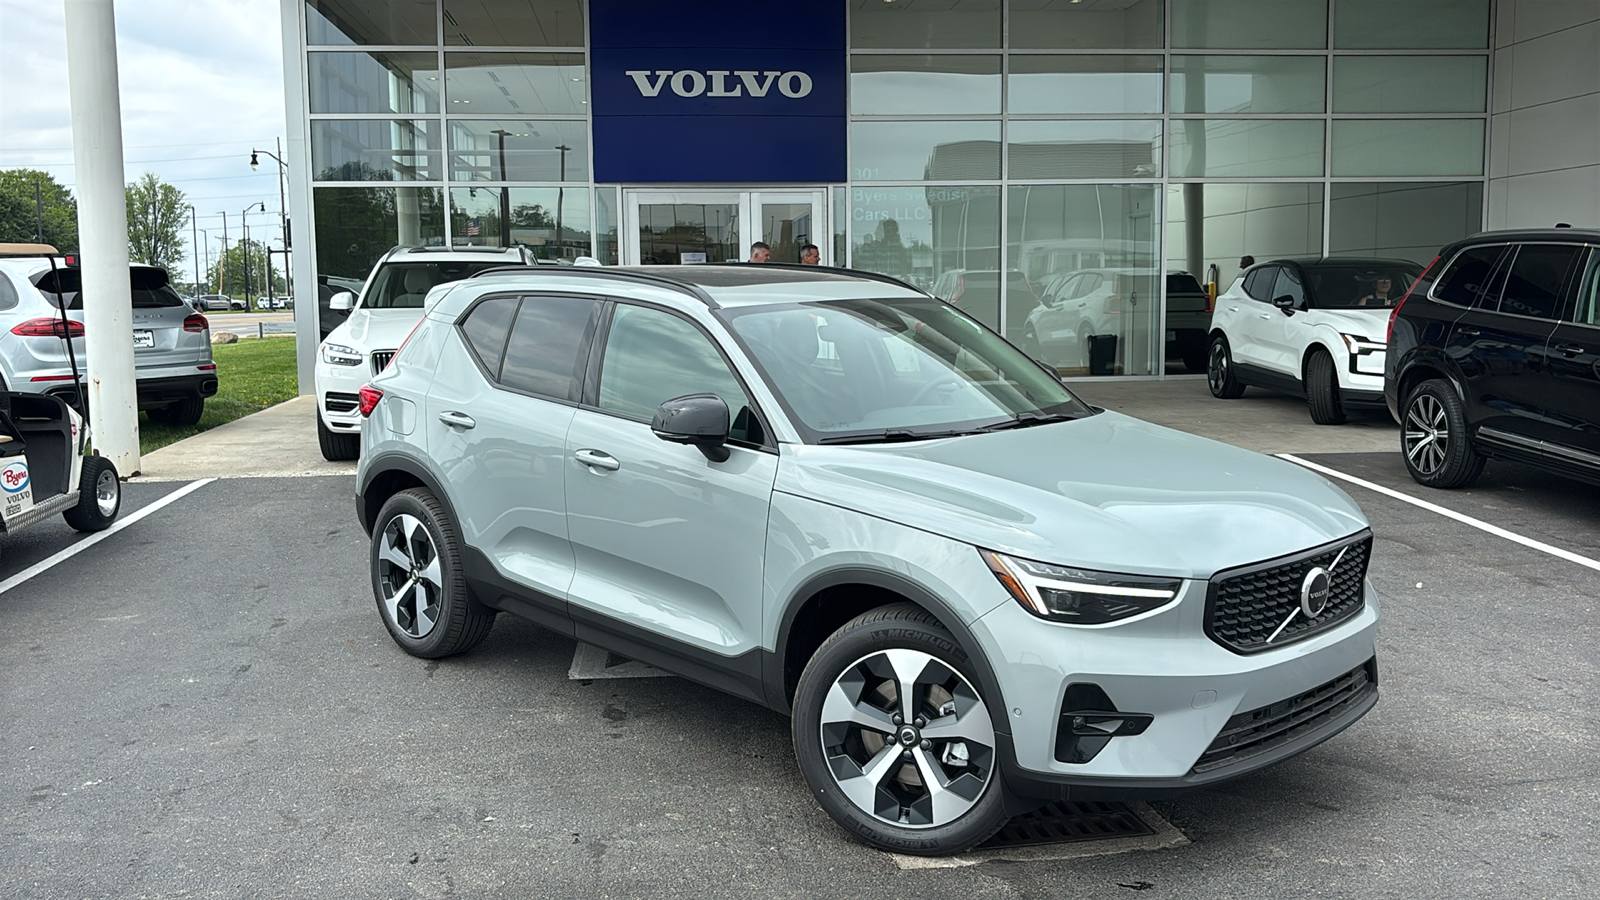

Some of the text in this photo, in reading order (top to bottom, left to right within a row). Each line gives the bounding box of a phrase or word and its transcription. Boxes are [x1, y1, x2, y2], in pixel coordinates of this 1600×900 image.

[625, 70, 813, 98] VOLVO
[854, 168, 880, 179] 301
[853, 189, 970, 205] Byers Swedish
[852, 207, 926, 221] Cars LLC
[2, 469, 28, 486] Byers
[6, 490, 31, 505] VOLVO
[887, 629, 952, 651] MICHELIN
